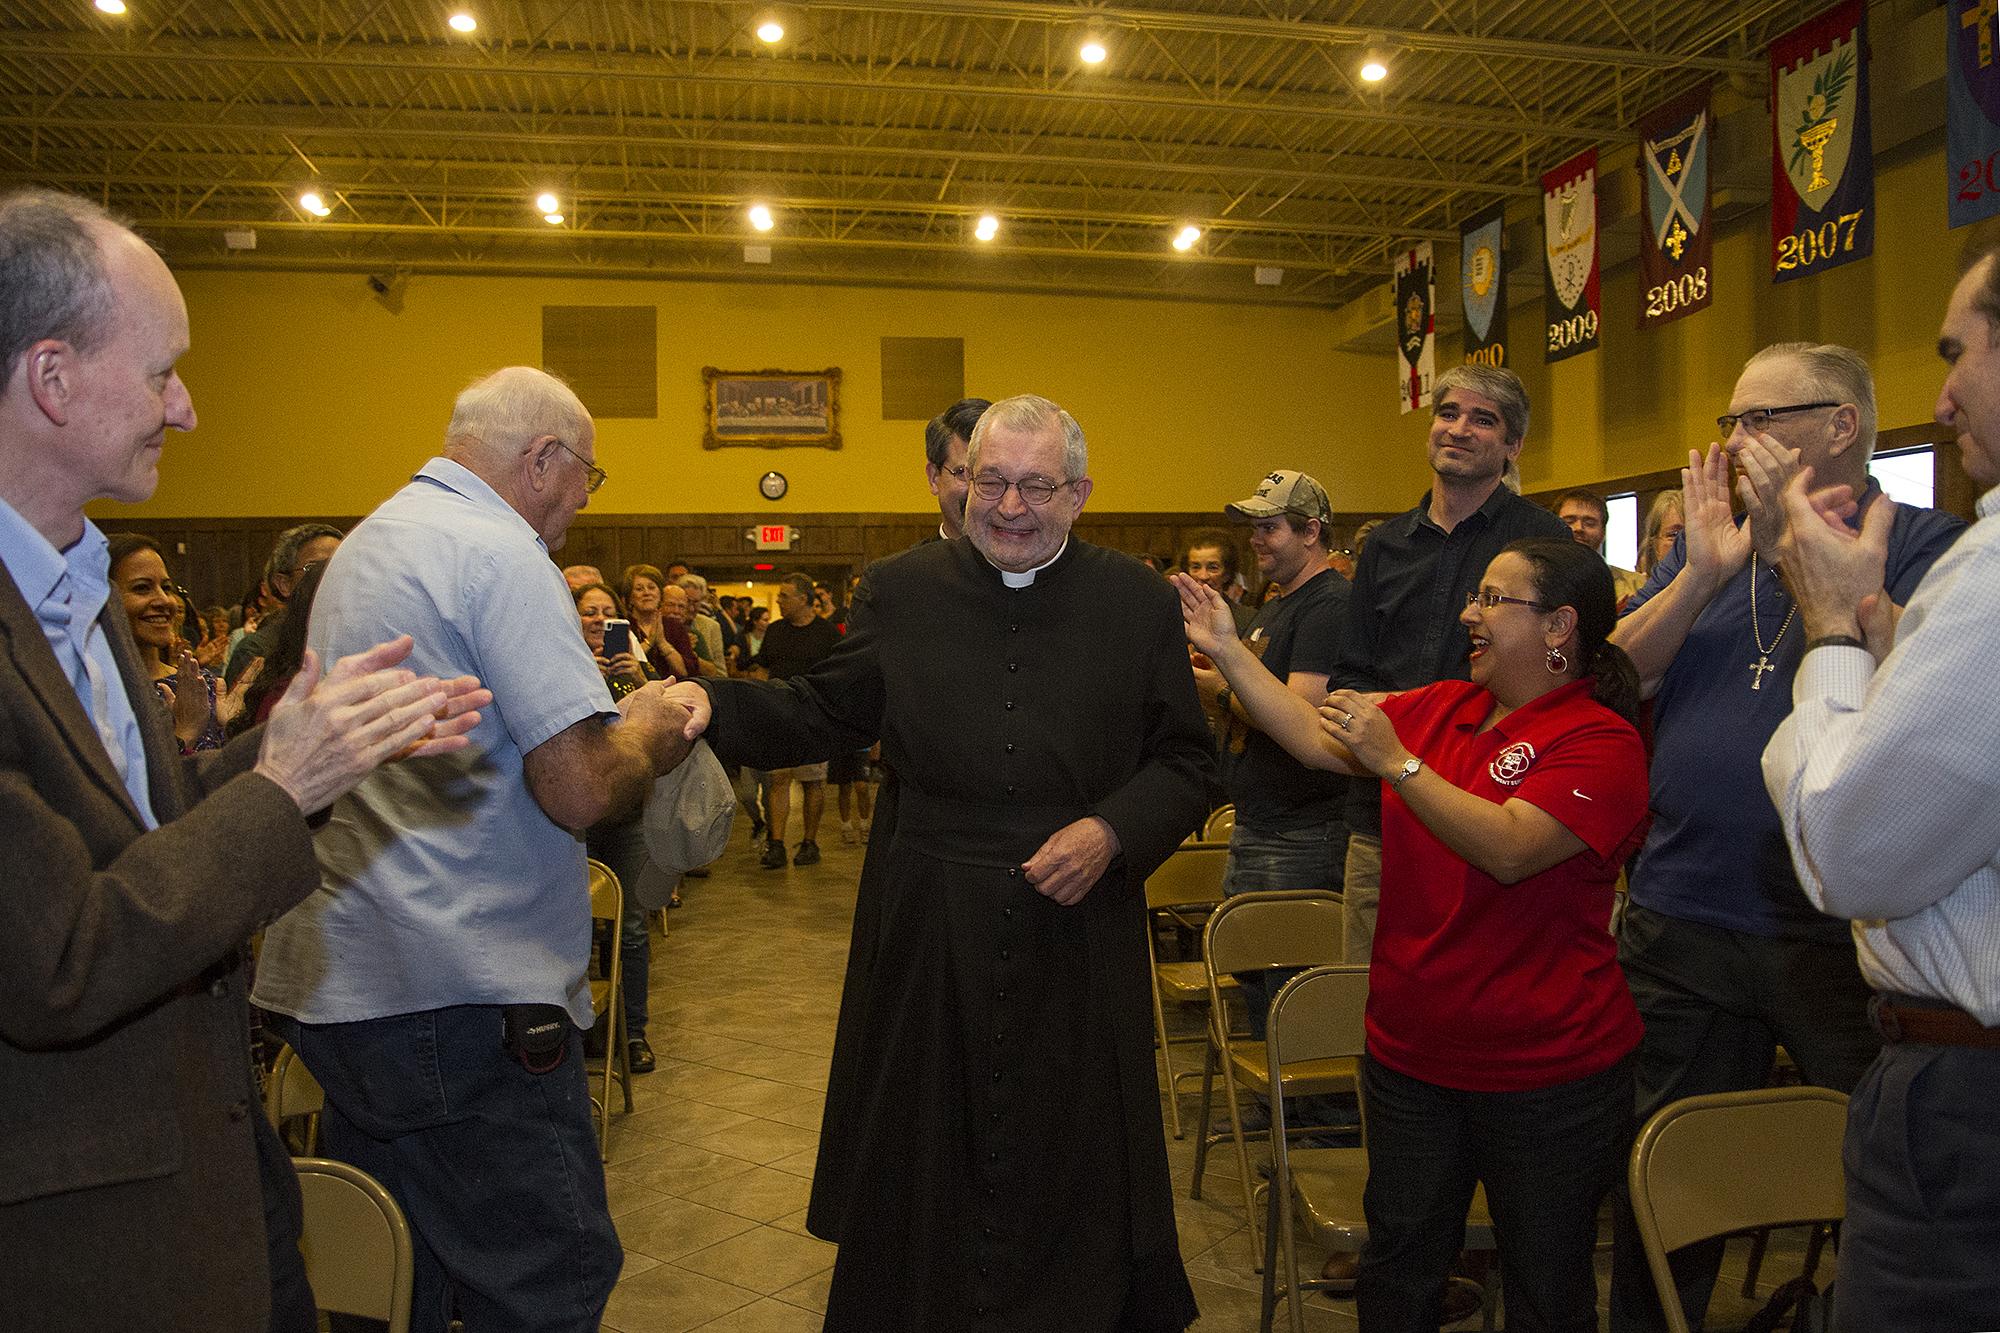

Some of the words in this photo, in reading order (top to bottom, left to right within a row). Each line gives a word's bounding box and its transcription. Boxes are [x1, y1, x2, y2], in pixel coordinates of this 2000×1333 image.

[1776, 208, 1864, 271] 2007
[1646, 266, 1708, 318] 2008
[1548, 310, 1599, 352] 2009
[762, 526, 784, 543] EXIT
